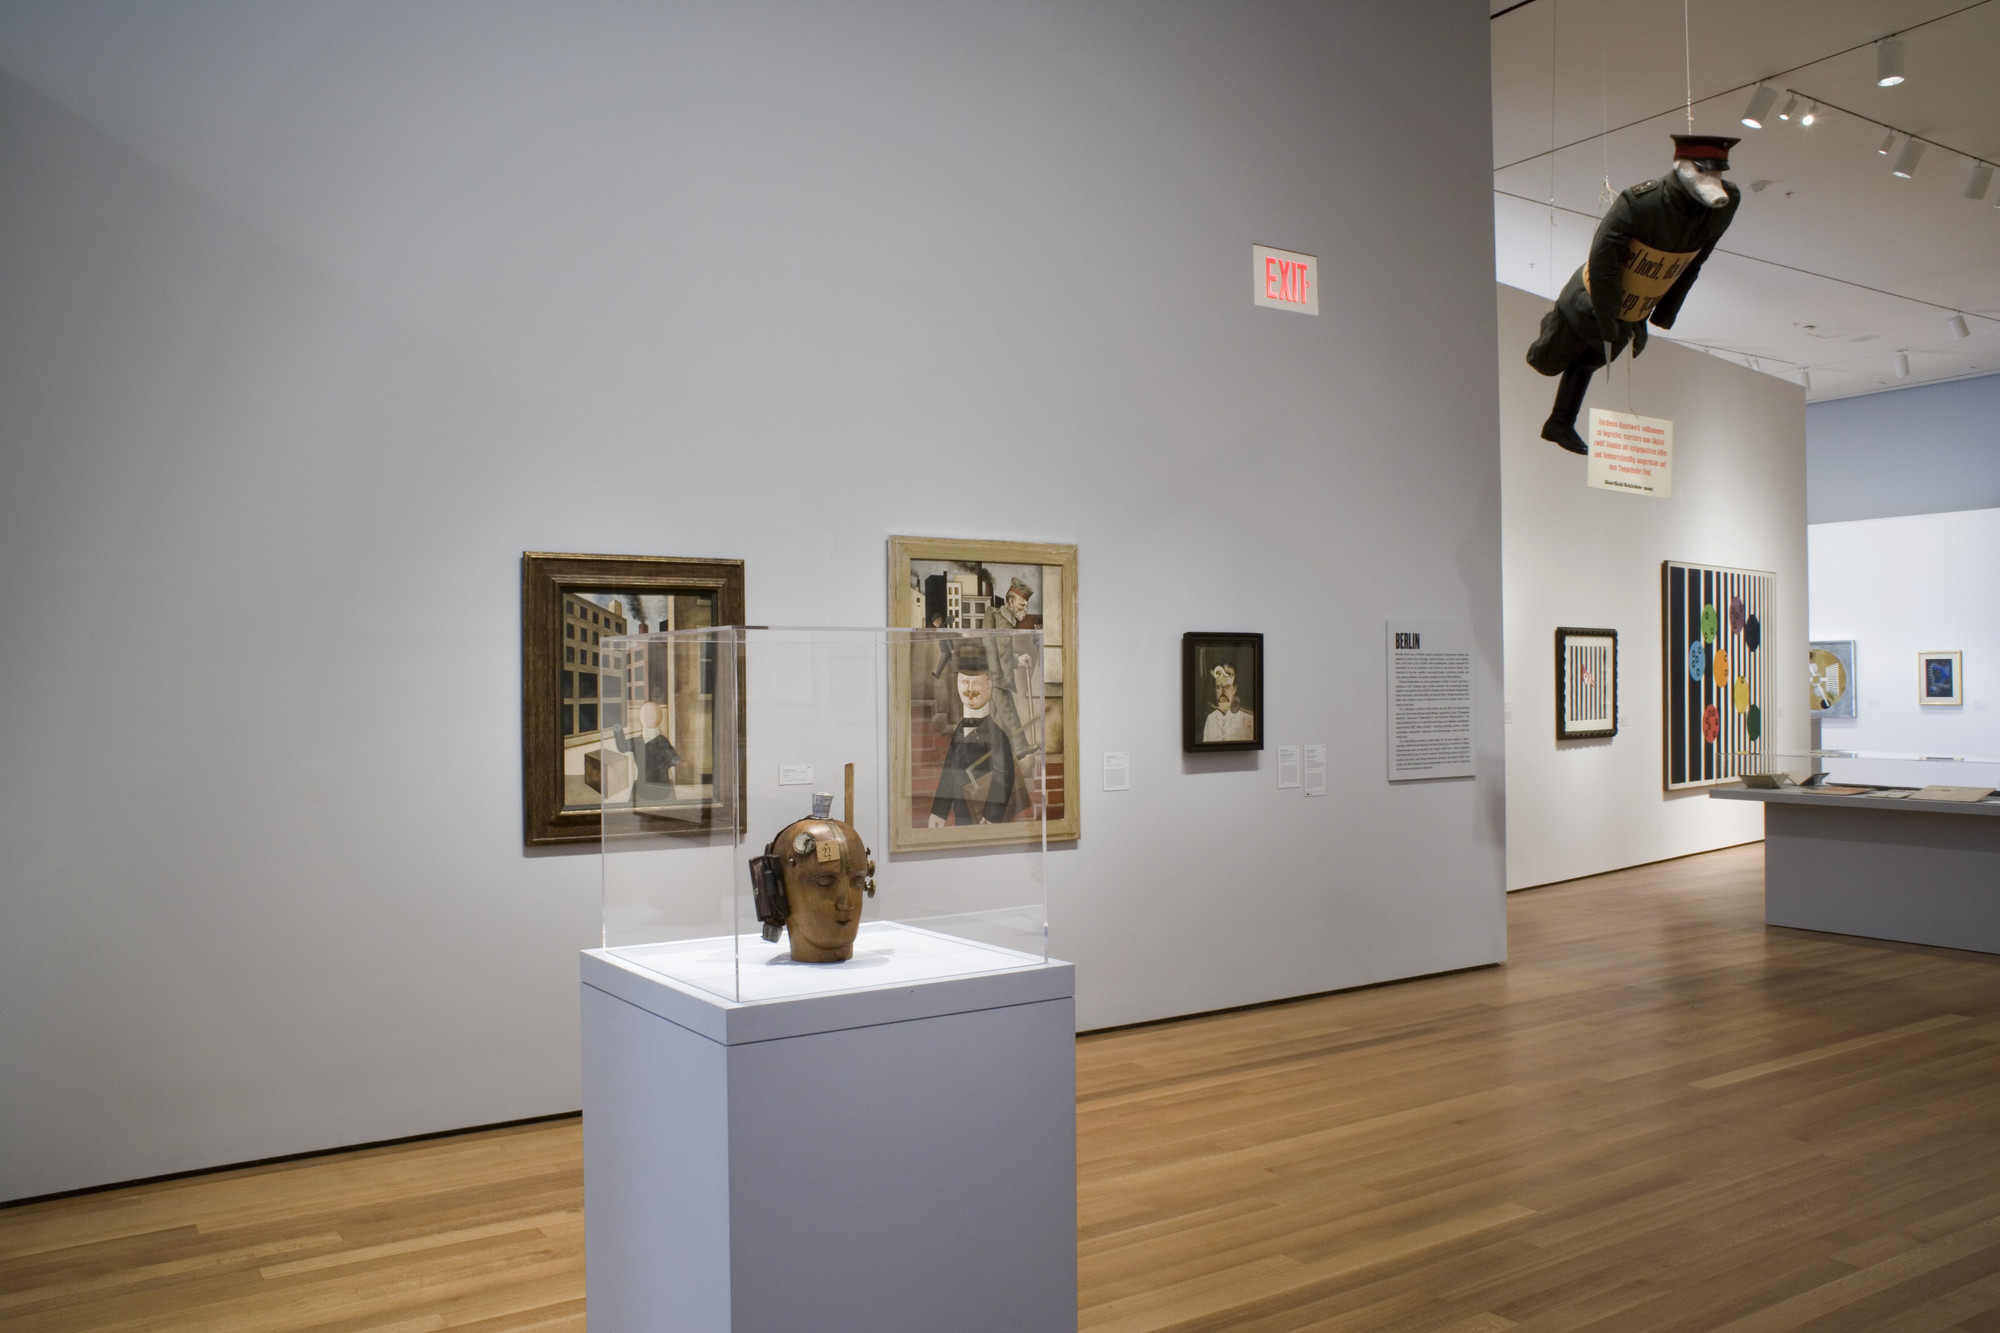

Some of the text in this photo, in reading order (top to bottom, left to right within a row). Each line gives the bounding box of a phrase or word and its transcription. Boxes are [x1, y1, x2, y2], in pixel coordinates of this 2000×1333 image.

[1265, 256, 1308, 304] EXIT
[1634, 252, 1665, 280] hoch,
[1395, 632, 1420, 650] BERLIN
